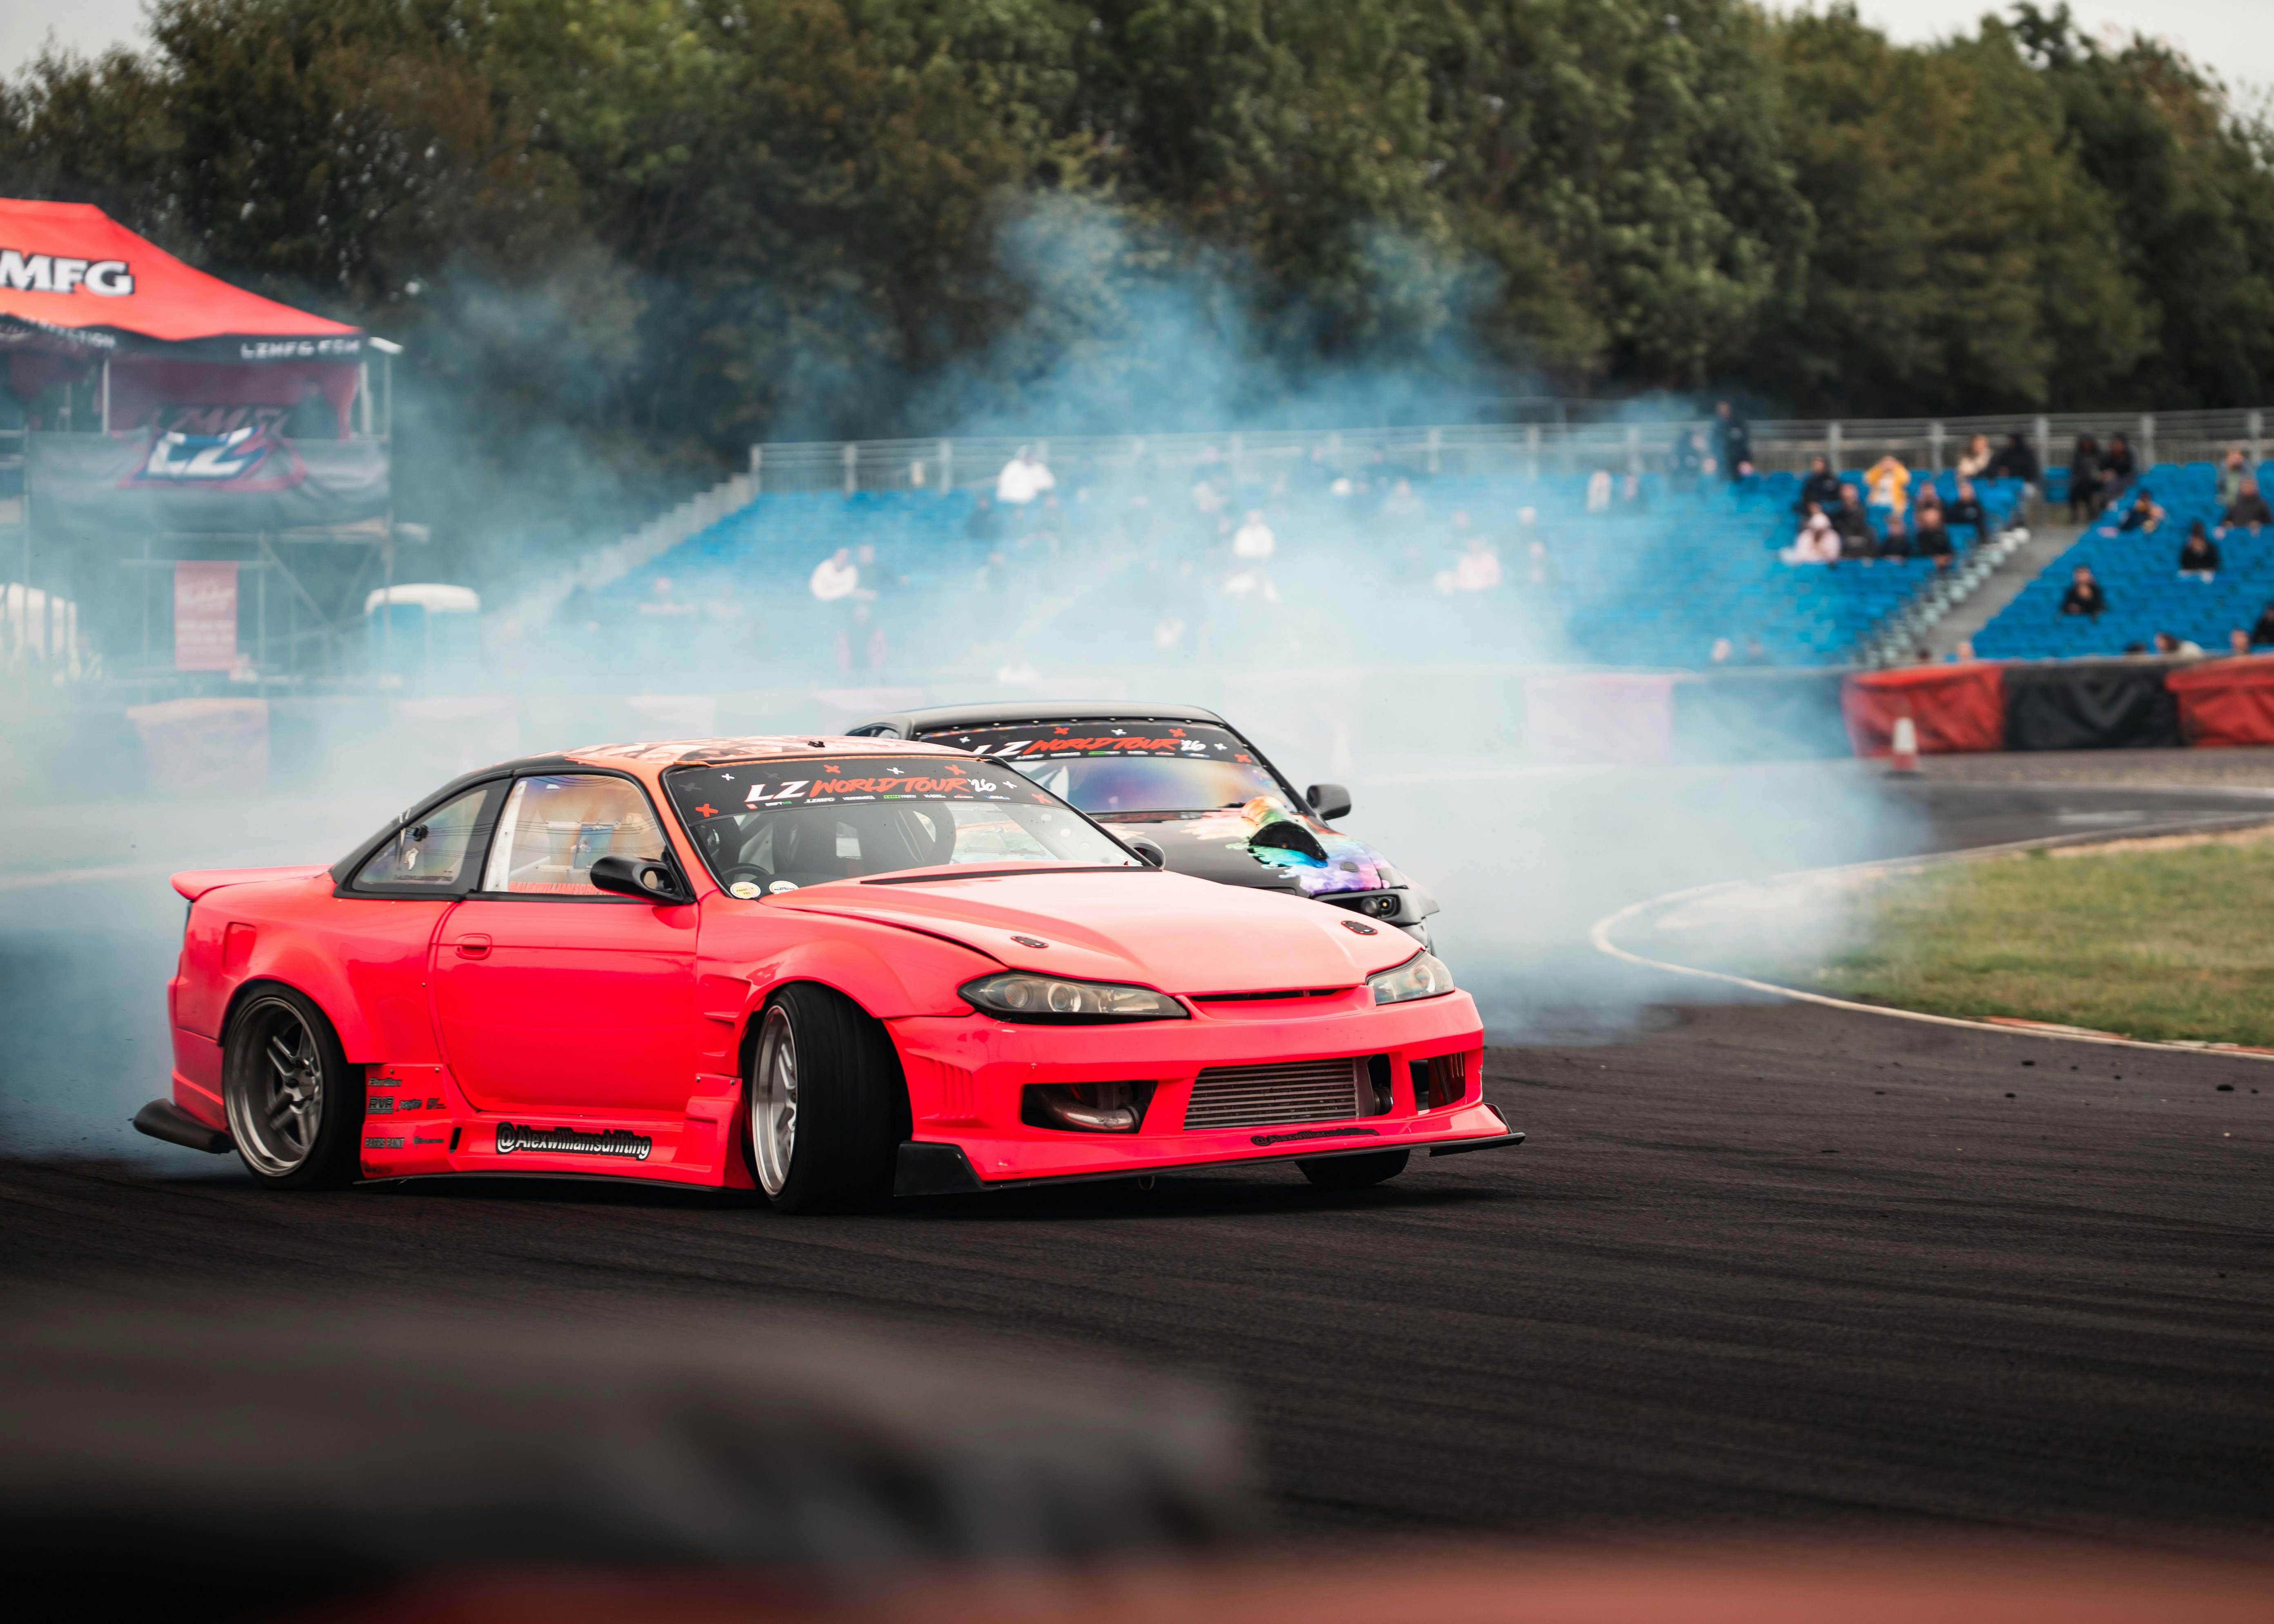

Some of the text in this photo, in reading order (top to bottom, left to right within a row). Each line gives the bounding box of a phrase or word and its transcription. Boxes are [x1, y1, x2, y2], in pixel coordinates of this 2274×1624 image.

[1022, 737, 1112, 755] WORLD
[1110, 737, 1181, 751] TOUR
[744, 781, 810, 803] LZ
[809, 777, 901, 798] WORLD
[895, 777, 971, 793] TOUR
[497, 1123, 650, 1159] @Alexwilliamsdrifting
